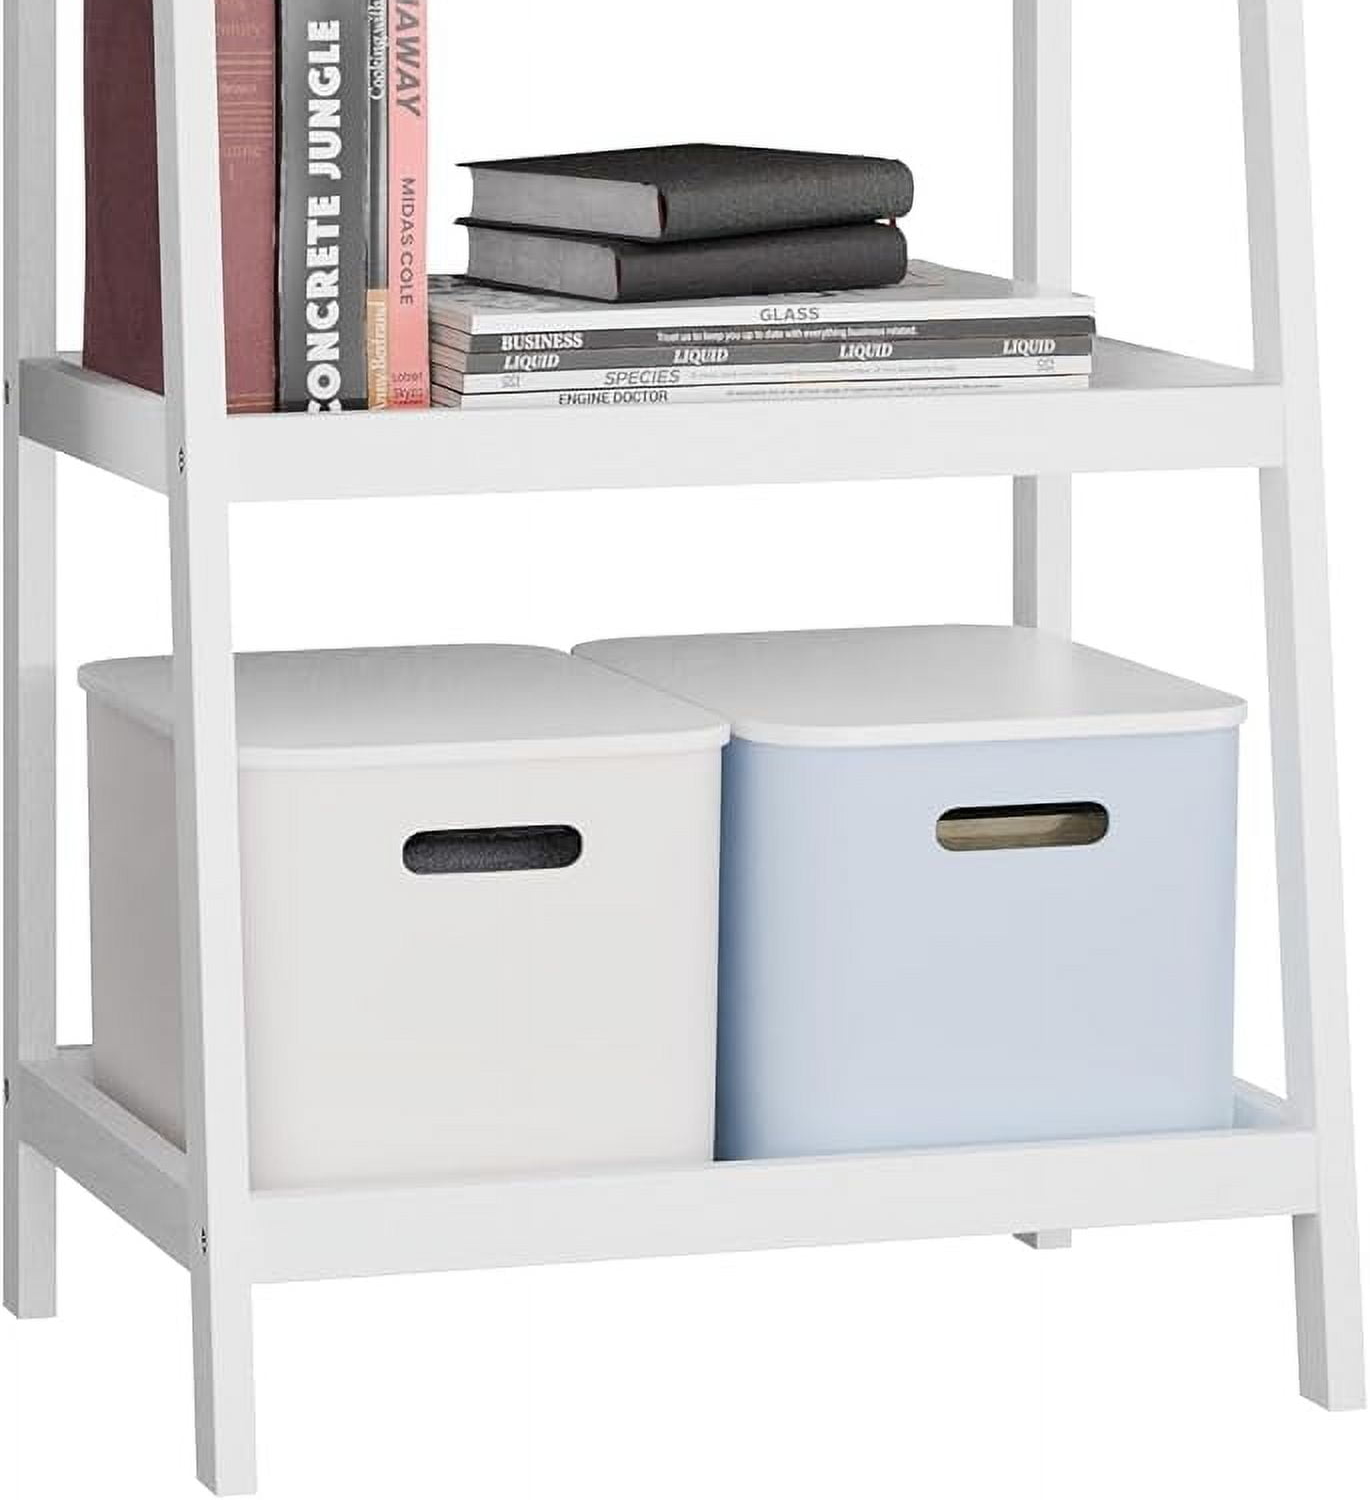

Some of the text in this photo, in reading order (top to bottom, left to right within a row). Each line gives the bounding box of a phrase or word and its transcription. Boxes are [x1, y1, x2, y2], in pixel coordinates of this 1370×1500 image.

[307, 19, 342, 180] JUNGLE
[400, 177, 416, 305] MIDAS COLE
[759, 307, 820, 322] GLASS
[501, 332, 584, 351] BUSINESS
[503, 338, 1056, 371] LIQUID LIQUID LIQUID LIQUID
[604, 369, 681, 386] SPECIES
[558, 390, 668, 405] ENGINE DOCTOR
